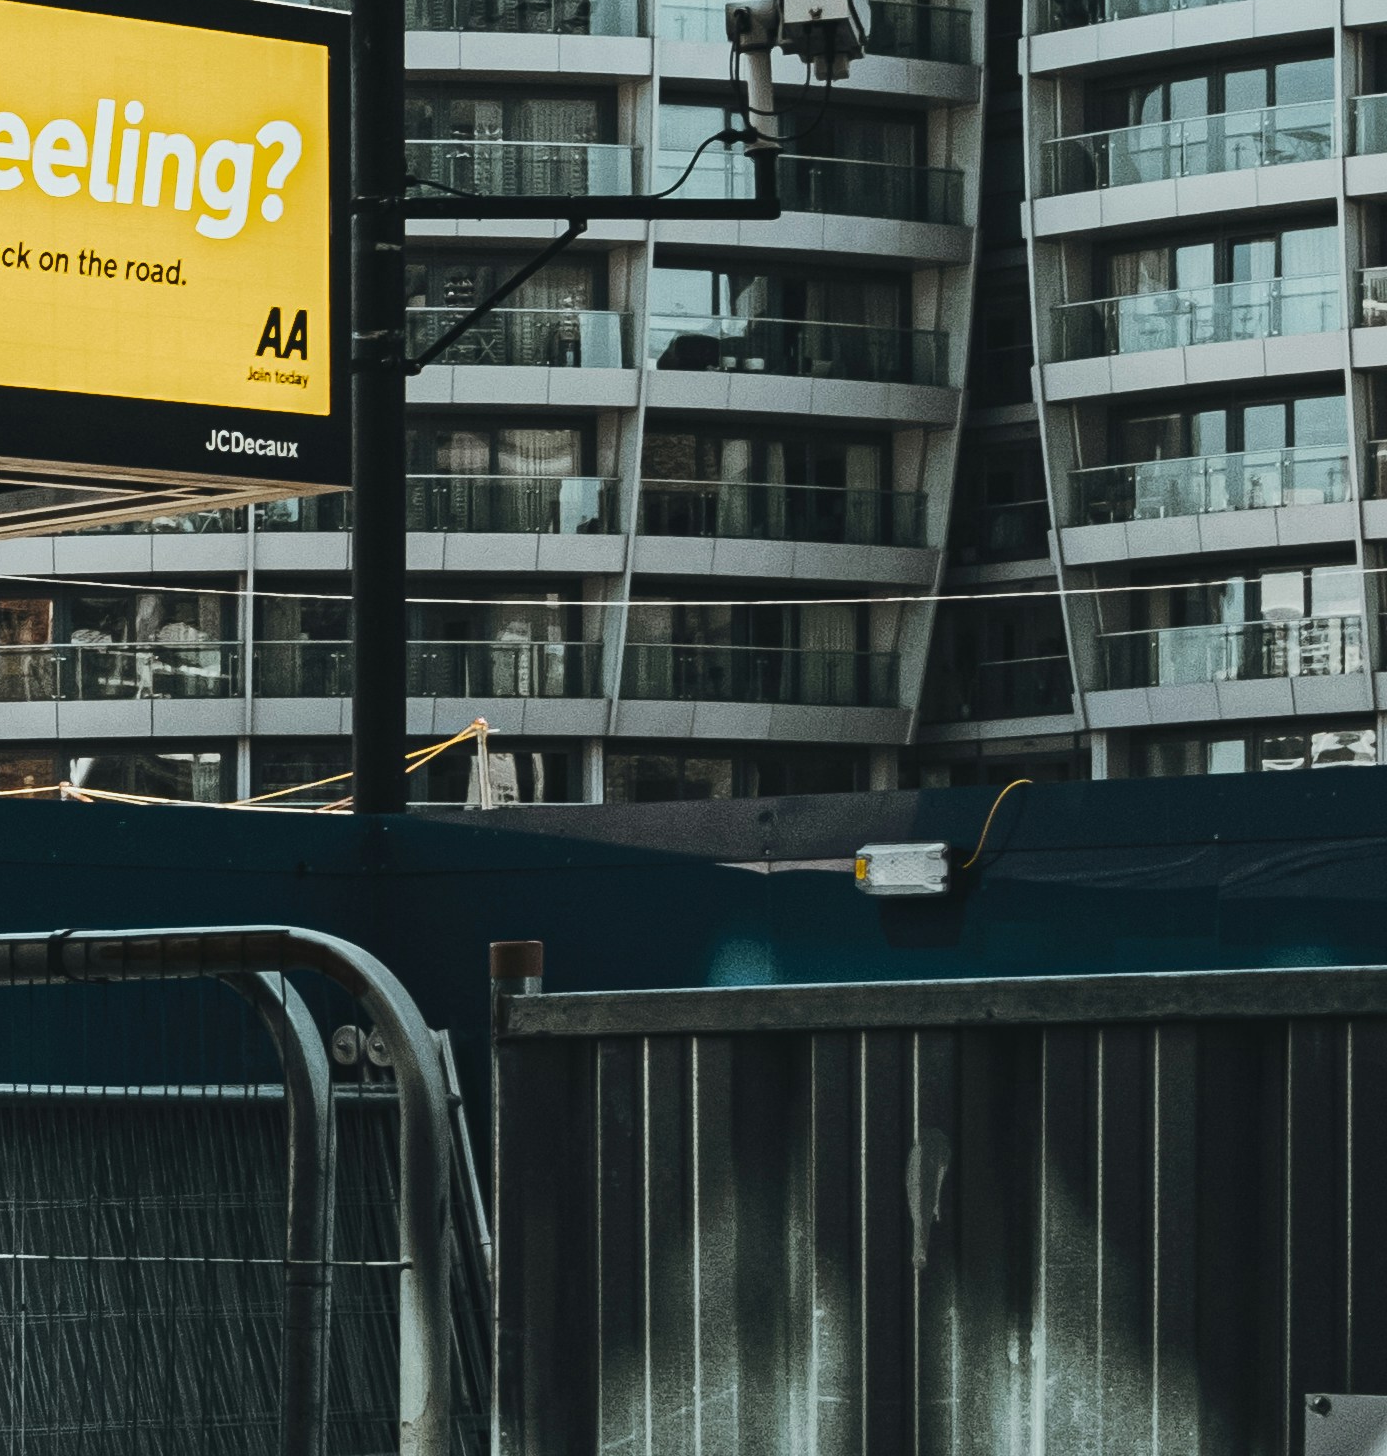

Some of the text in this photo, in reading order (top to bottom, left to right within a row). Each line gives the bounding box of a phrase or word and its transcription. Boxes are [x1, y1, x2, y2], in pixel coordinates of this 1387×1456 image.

[38, 248, 70, 274] on
[78, 248, 118, 278] the
[125, 258, 188, 287] road.
[255, 307, 308, 361] AA
[247, 367, 309, 388] Join today
[206, 429, 299, 458] JCDecaux
